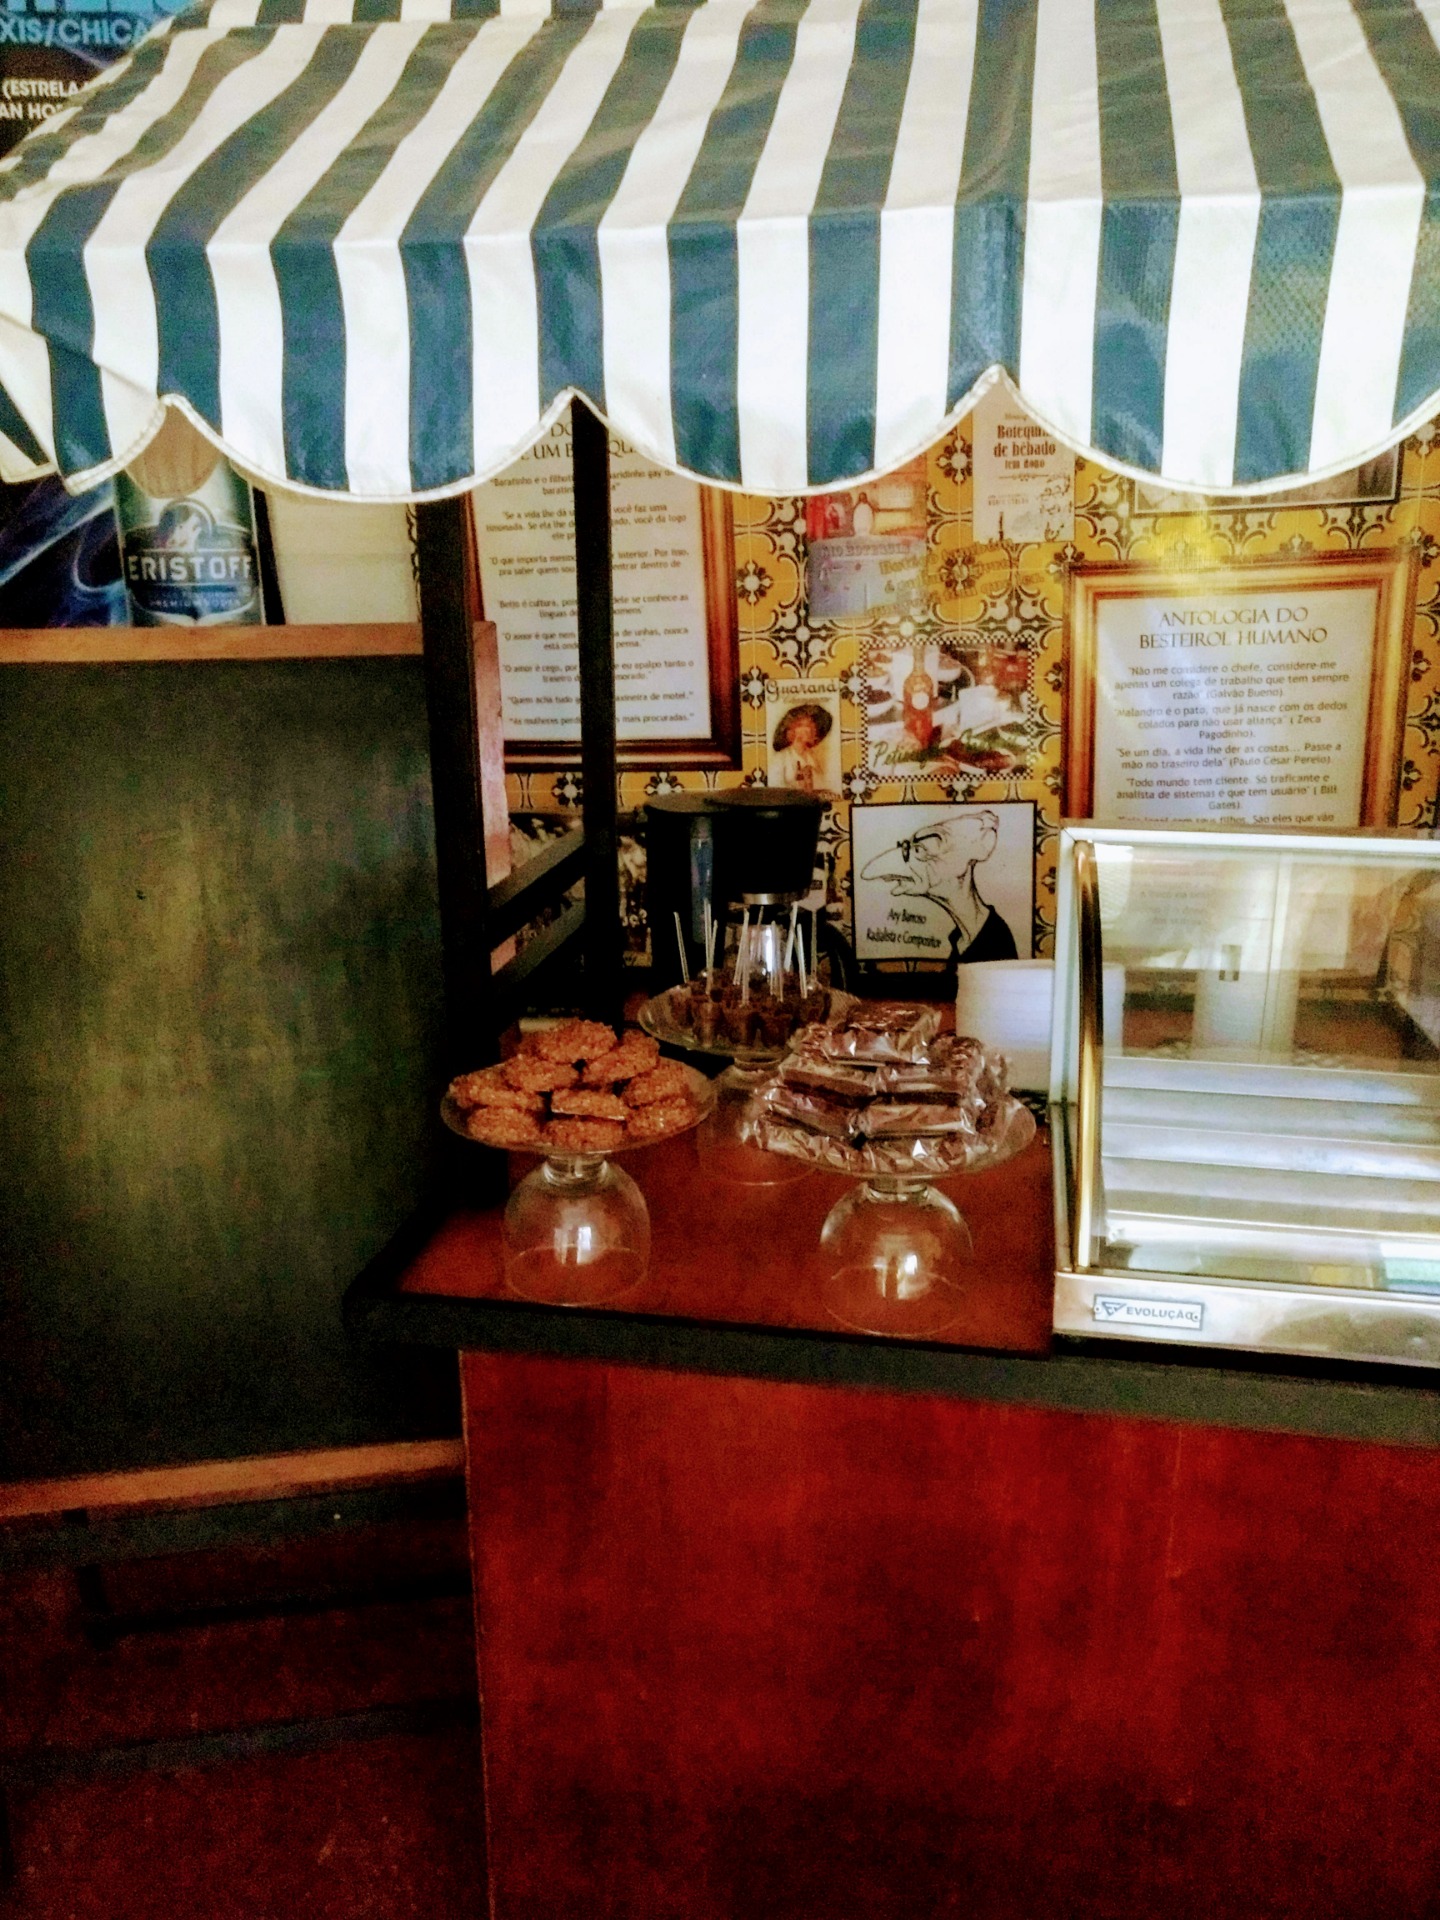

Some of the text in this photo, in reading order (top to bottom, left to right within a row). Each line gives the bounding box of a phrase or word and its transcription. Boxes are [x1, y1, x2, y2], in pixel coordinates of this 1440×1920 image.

[533, 444, 561, 459] UM
[993, 442, 1008, 458] de
[128, 556, 252, 580] ERISTOFF
[1160, 606, 1308, 627] ANTOLOGIA DO
[1140, 627, 1328, 650] BESTEIROL HUMANO
[1153, 665, 1169, 675] me
[1221, 665, 1228, 673] o
[1267, 660, 1337, 672] considere-me
[1114, 680, 1149, 692] apenas
[1151, 680, 1167, 689] um
[1204, 676, 1217, 686] de
[1219, 675, 1263, 687] trabalho
[1265, 676, 1285, 687] que
[1288, 674, 1308, 685] tem
[1311, 673, 1350, 685] sempre
[1174, 707, 1181, 716] o
[1212, 705, 1231, 716] que
[1246, 704, 1276, 713] nasce
[1278, 703, 1300, 712] com
[1303, 702, 1315, 711] os
[1317, 701, 1348, 711] dedos
[1137, 719, 1176, 730] colados
[1178, 719, 1200, 732] para
[1202, 717, 1220, 727] não
[1222, 718, 1243, 727] usar
[1297, 714, 1322, 725] Zeca
[1133, 749, 1149, 758] um
[1184, 745, 1204, 756] vida
[1207, 744, 1222, 755] lhe
[1224, 744, 1241, 755] der
[1244, 745, 1255, 754] as
[1304, 742, 1333, 753] Passe
[1335, 743, 1342, 751] a
[1121, 759, 1143, 770] mão
[1146, 760, 1159, 769] no
[1161, 758, 1200, 769] traseiro
[1156, 777, 1190, 788] mundo
[1193, 776, 1212, 786] tem
[1270, 773, 1321, 784] traficante
[1116, 789, 1155, 800] analista
[1158, 789, 1170, 800] de
[1173, 788, 1216, 799] sistemas
[1227, 788, 1246, 799] que
[1248, 787, 1268, 797] tem
[1295, 814, 1314, 824] que
